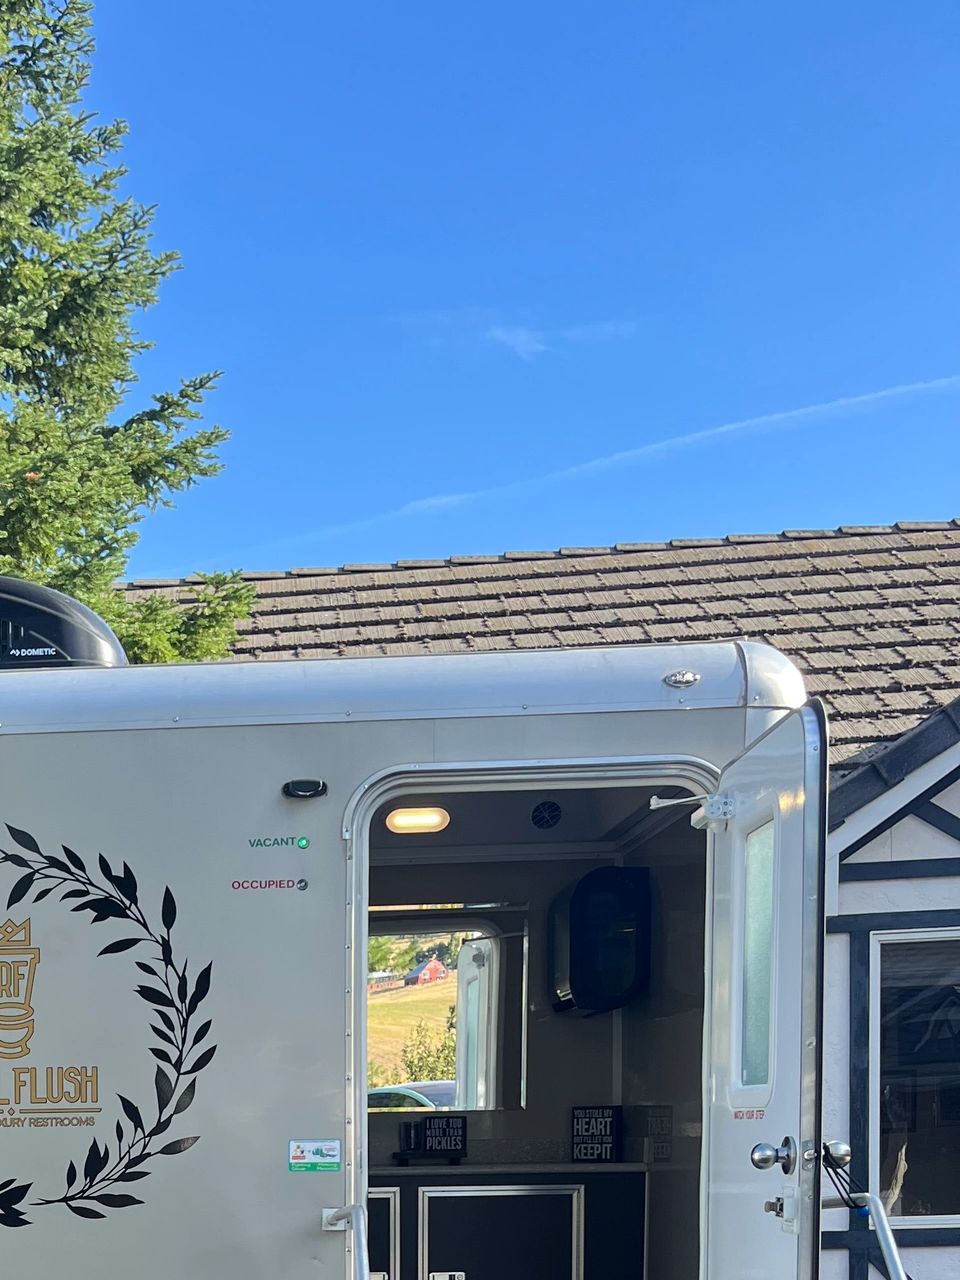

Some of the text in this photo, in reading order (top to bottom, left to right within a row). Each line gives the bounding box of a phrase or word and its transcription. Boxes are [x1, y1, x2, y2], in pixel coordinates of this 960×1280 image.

[21, 648, 56, 657] DOMETIC
[248, 837, 296, 847] VACANT
[231, 880, 295, 890] OCCUPIED
[12, 1066, 98, 1104] FLUSH
[29, 1116, 96, 1127] RESTROOMS
[431, 1118, 447, 1128] LOVE
[573, 1118, 613, 1135] HEART
[426, 1136, 462, 1150] PICKLES
[573, 1144, 613, 1159] KEEP IT
